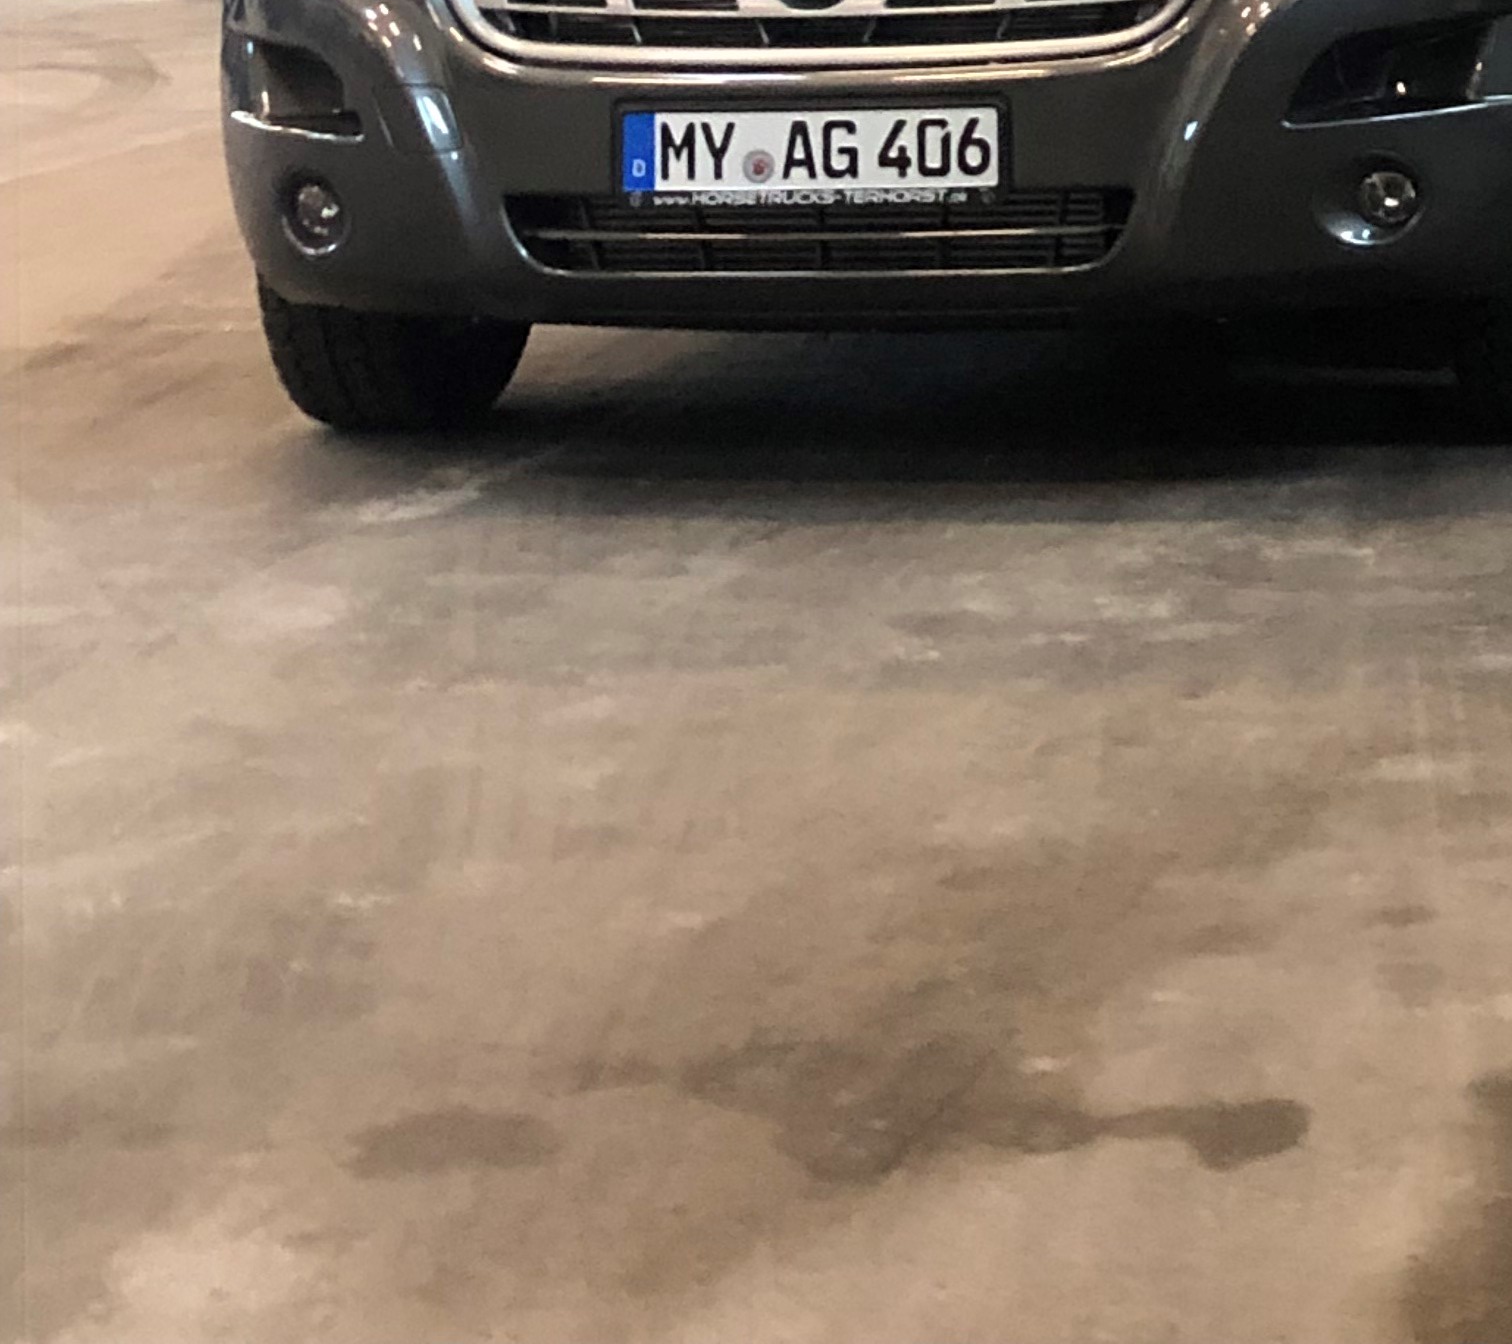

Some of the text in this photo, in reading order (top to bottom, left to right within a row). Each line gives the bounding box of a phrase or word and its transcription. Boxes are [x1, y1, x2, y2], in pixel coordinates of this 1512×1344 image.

[631, 158, 646, 177] D
[661, 117, 991, 180] MY AG 406
